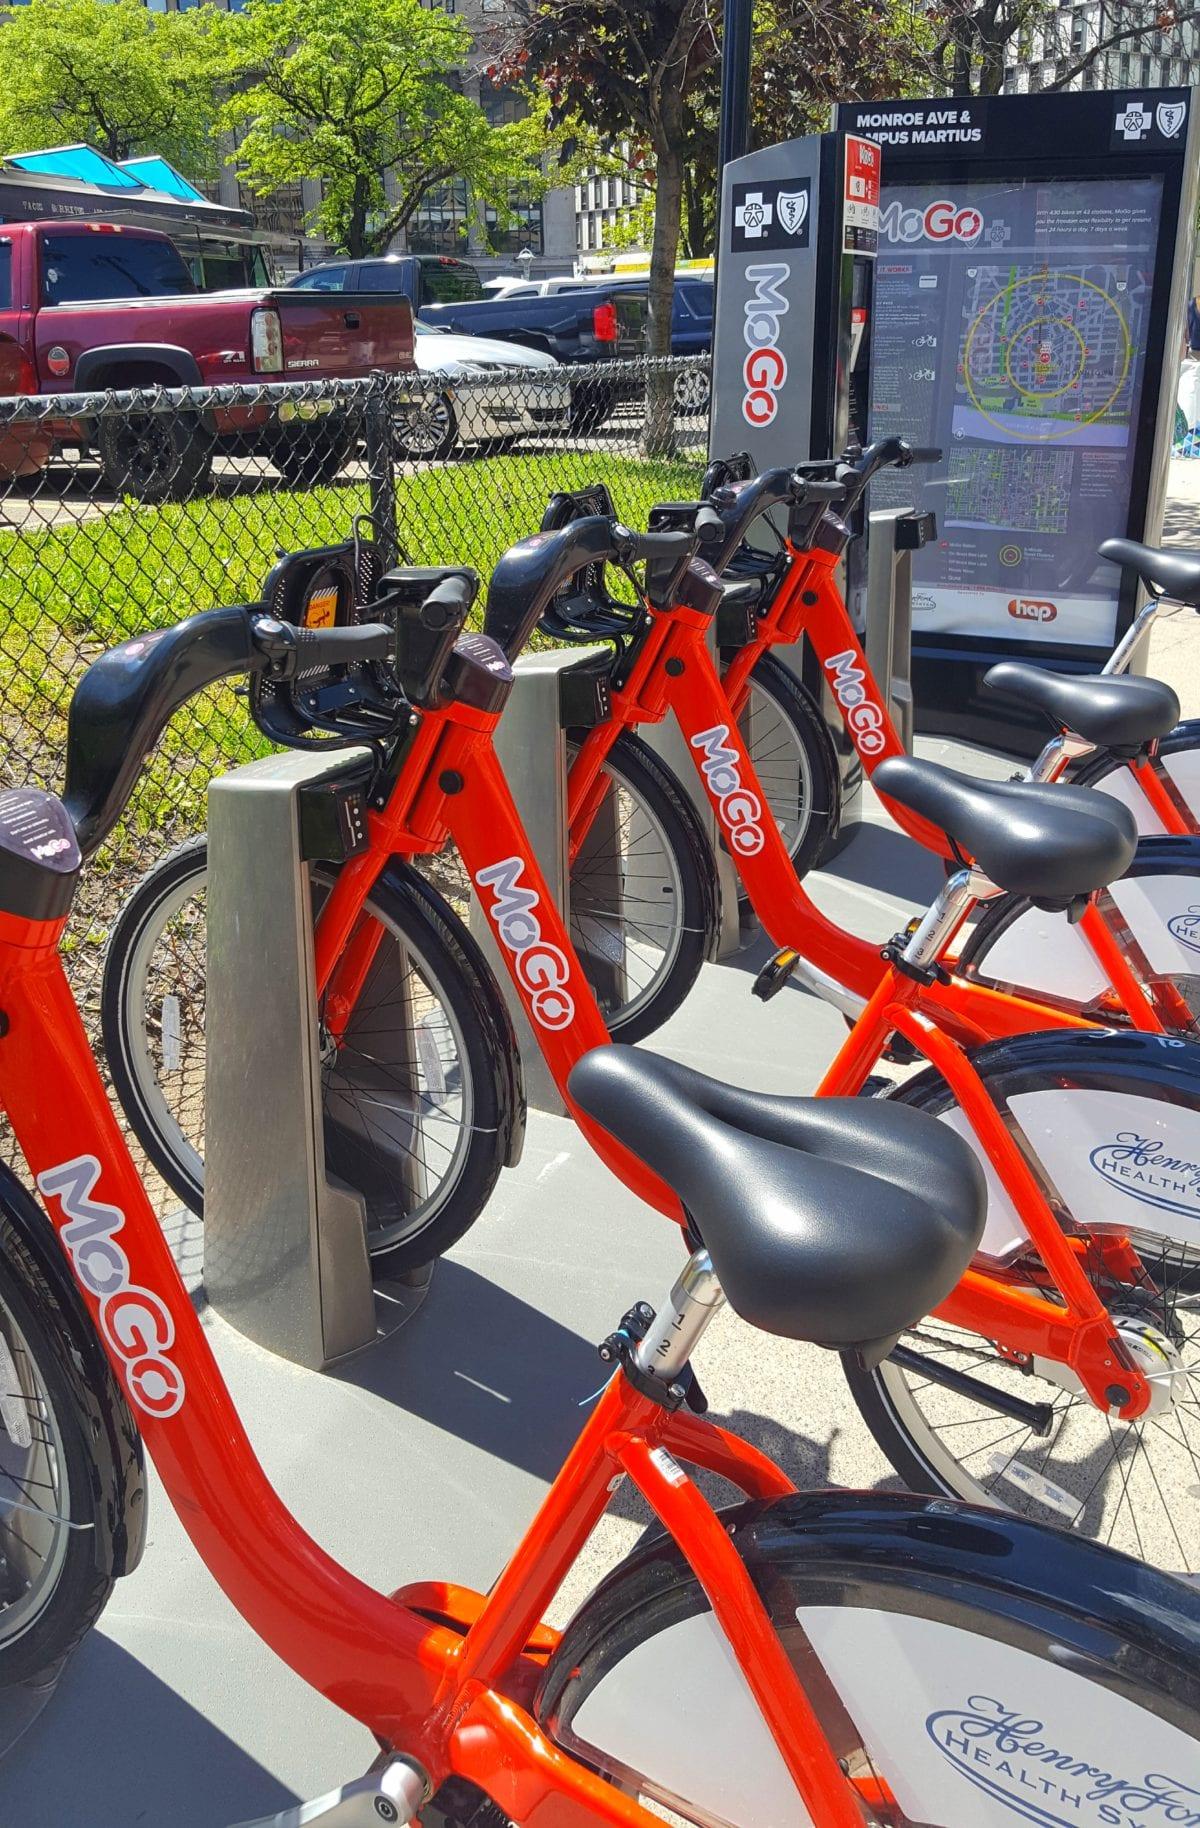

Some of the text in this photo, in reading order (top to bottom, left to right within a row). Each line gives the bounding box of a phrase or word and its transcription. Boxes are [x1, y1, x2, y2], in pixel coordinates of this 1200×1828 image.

[856, 110, 971, 127] MONROE AVE &
[860, 128, 982, 144] MPUS MARTIUS
[287, 359, 319, 368] SIERRA
[741, 263, 791, 428] MoGo
[1015, 599, 1052, 623] hap
[824, 649, 886, 756] MoGo
[690, 724, 765, 857] MoGo
[475, 856, 576, 1032] MoGo
[1101, 1158, 1187, 1194] HEALTH
[37, 1154, 186, 1419] MoGo
[659, 1339, 671, 1353] 2
[678, 1313, 686, 1325] 1
[945, 1729, 1082, 1809] HEALTH
[960, 1695, 1130, 1801] Henry
